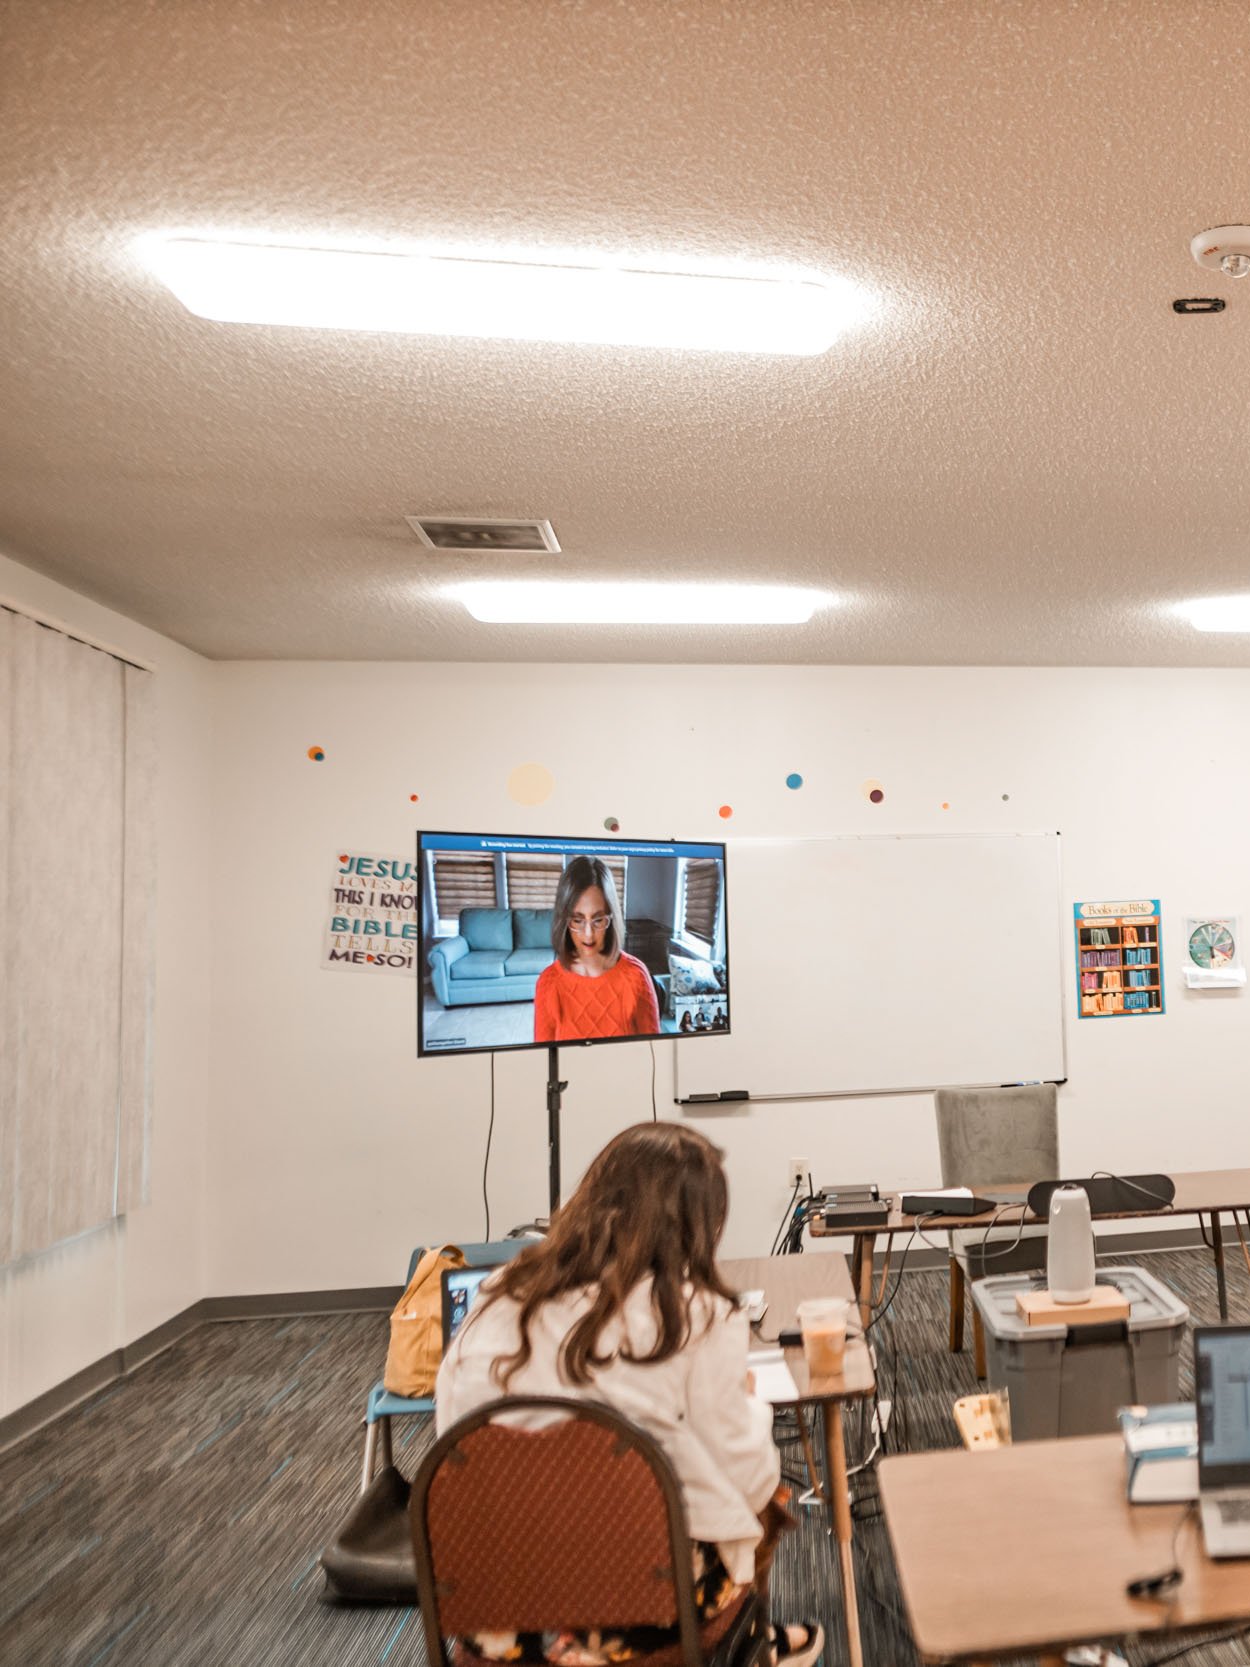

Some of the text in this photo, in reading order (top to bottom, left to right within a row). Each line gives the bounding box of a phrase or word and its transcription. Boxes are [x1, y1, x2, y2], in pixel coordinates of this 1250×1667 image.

[339, 876, 392, 891] LOVES
[334, 887, 417, 910] THIS I KNO
[334, 904, 375, 920] FOR
[1088, 904, 1112, 915] Books
[1129, 903, 1149, 914] Bible
[331, 917, 417, 940] BIBLE
[330, 934, 414, 954] TELLS
[328, 949, 413, 969] ME SO!
